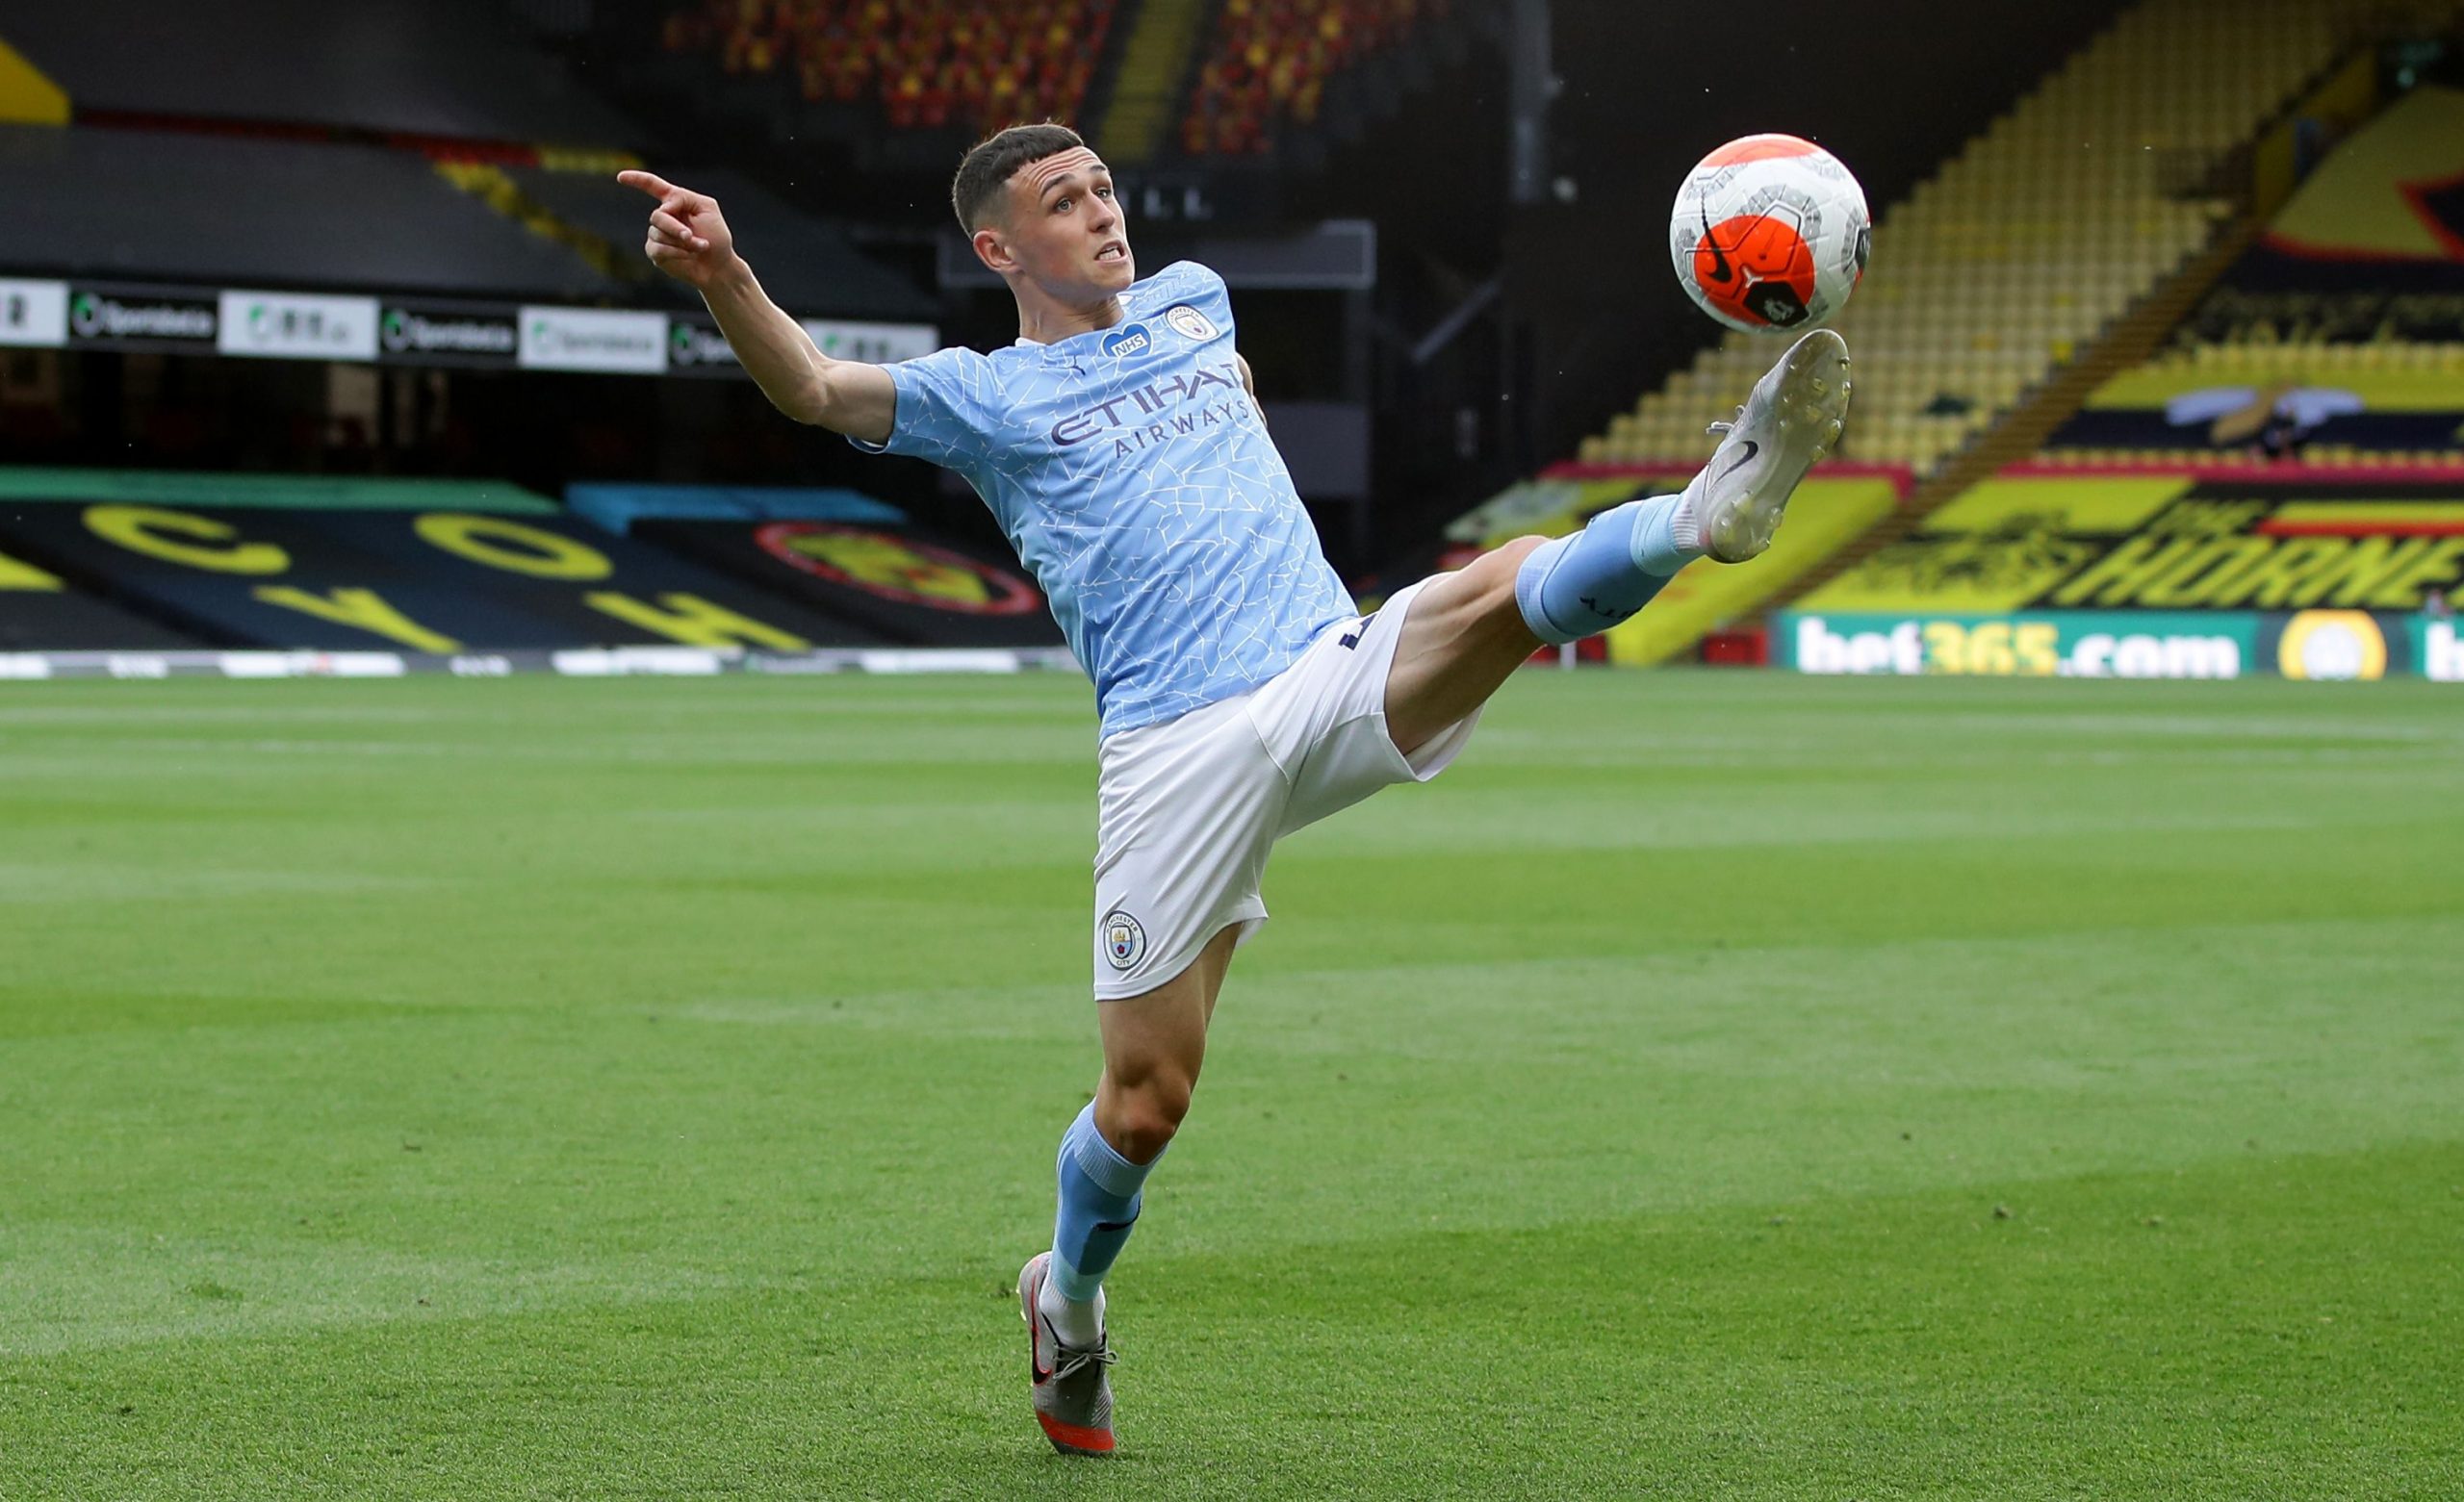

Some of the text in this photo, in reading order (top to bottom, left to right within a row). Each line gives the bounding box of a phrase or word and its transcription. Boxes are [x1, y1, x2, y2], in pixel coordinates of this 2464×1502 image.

[1114, 336, 1145, 357] NHS
[1115, 398, 1249, 459] AIRWAYS
[2050, 535, 2464, 607] HORNE
[1797, 616, 2241, 679] bet365.com
